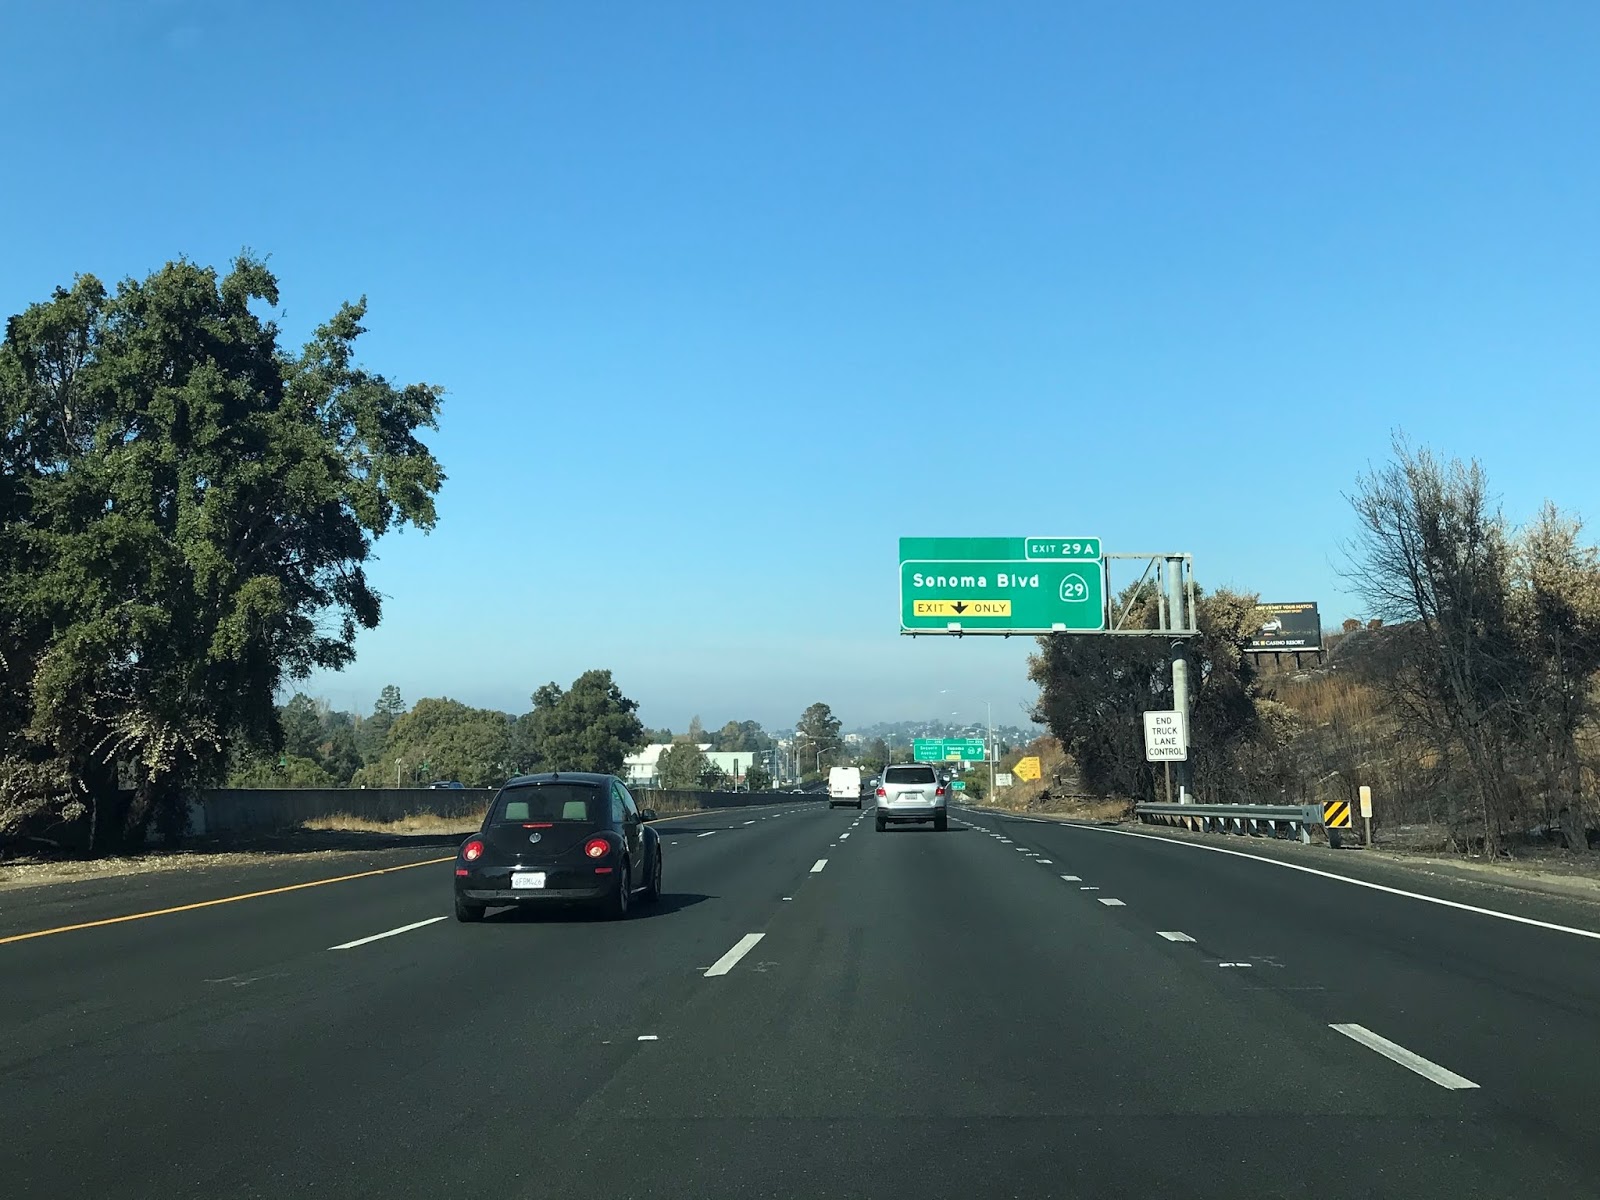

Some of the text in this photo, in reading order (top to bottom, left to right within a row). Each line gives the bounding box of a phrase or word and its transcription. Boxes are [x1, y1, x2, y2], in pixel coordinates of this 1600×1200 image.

[1032, 544, 1094, 554] EXIT 29A
[913, 573, 1039, 588] Sonoma Blvd
[1064, 583, 1084, 597] 29
[918, 604, 1006, 612] EXIT ONLY
[1156, 717, 1172, 725] END
[1152, 727, 1178, 735] TRUCK
[1149, 747, 1184, 756] CONTROL
